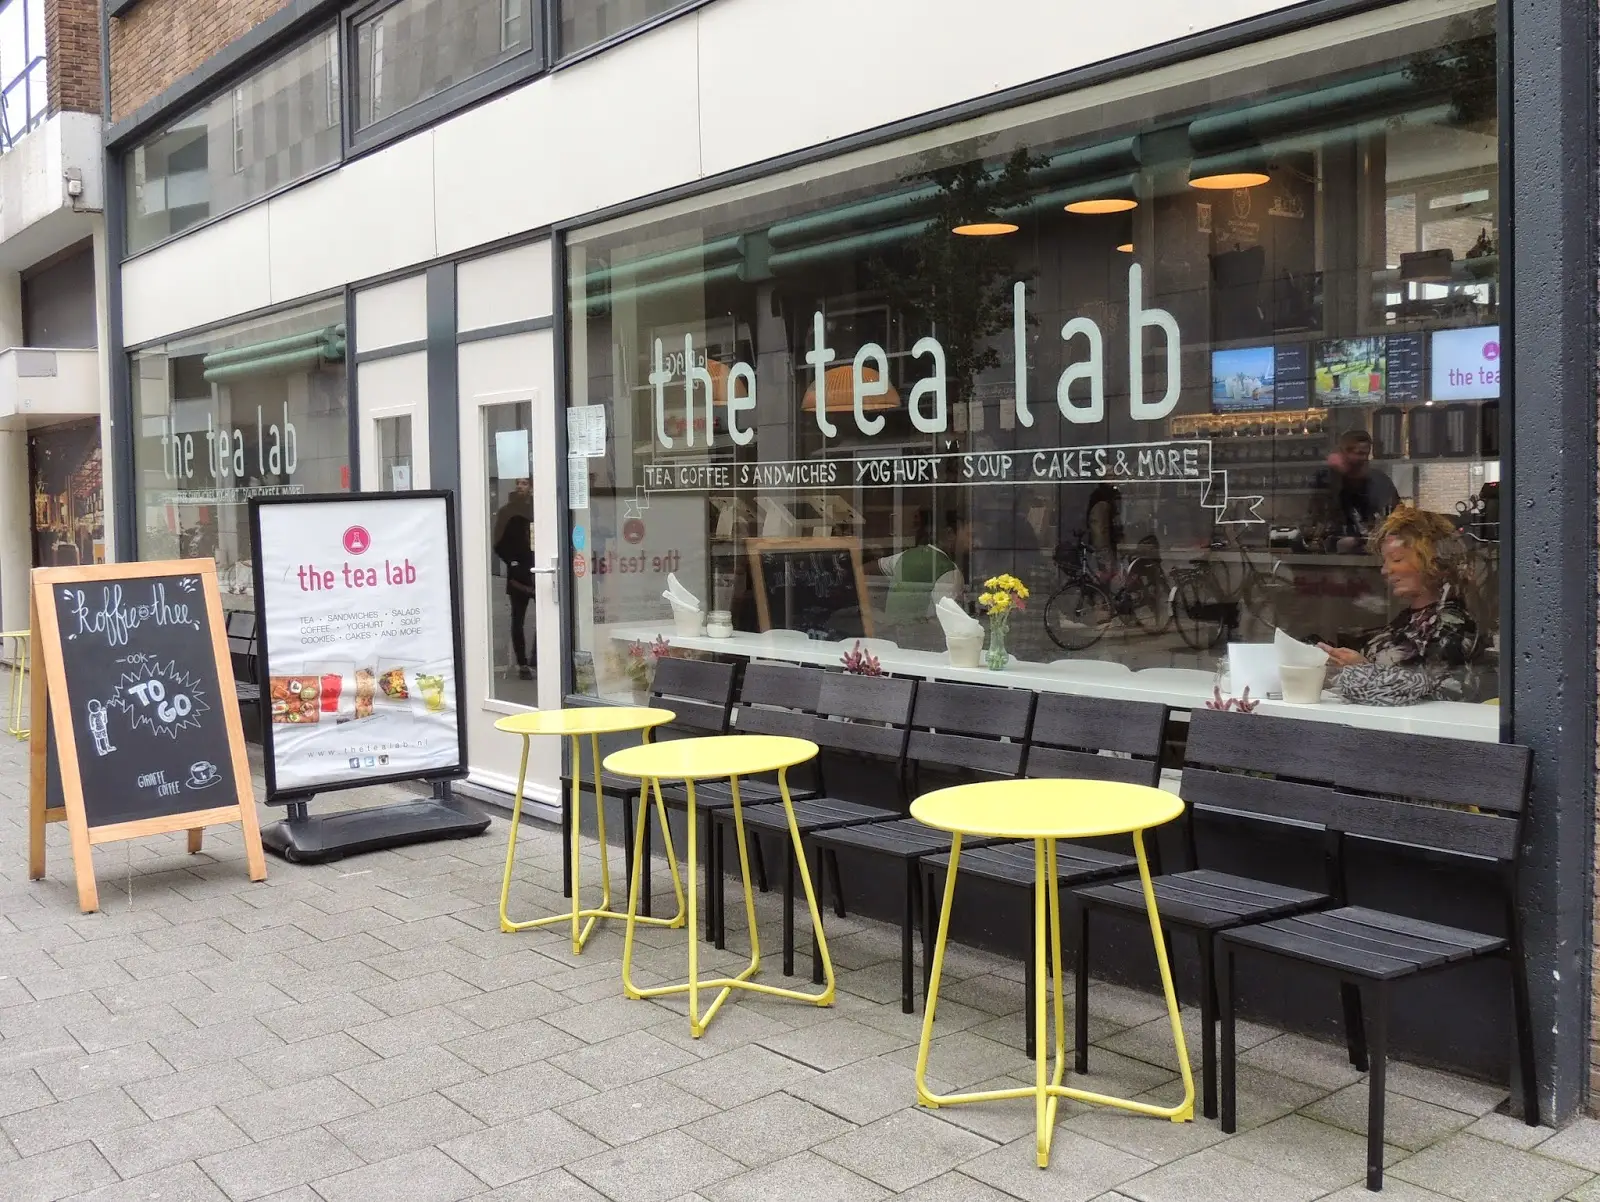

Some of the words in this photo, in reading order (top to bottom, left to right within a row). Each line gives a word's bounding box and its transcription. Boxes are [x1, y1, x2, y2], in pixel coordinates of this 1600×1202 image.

[648, 332, 757, 449] the
[805, 310, 947, 438] tea
[1014, 262, 1181, 428] lab
[1448, 367, 1473, 386] the
[161, 414, 194, 480] the
[206, 412, 245, 478] tea
[258, 401, 298, 476] lab
[645, 467, 673, 487] TEA
[680, 465, 730, 487] COFFEE
[740, 462, 837, 485] SANDWICHES
[855, 457, 941, 482] YOGHURT
[963, 454, 1013, 479] SOUP
[1032, 448, 1107, 479] CAKES
[1113, 450, 1132, 477] &
[1138, 448, 1199, 478] MORE
[297, 564, 335, 591] the
[342, 561, 377, 588] tea
[385, 558, 417, 586] lab
[71, 583, 141, 647] koffie
[150, 582, 193, 626] thee
[300, 616, 315, 625] TEA
[327, 611, 379, 622] SANDWICHES
[391, 607, 421, 617] SALADS
[300, 624, 331, 634] COFFEE
[346, 620, 384, 631] YOGHURT
[400, 617, 421, 626] SOUP
[300, 634, 336, 645] COOKIES
[345, 631, 371, 641] CAKES
[381, 629, 397, 638] AND
[399, 627, 422, 636] MORE
[128, 679, 165, 707] TO
[157, 693, 192, 723] GO
